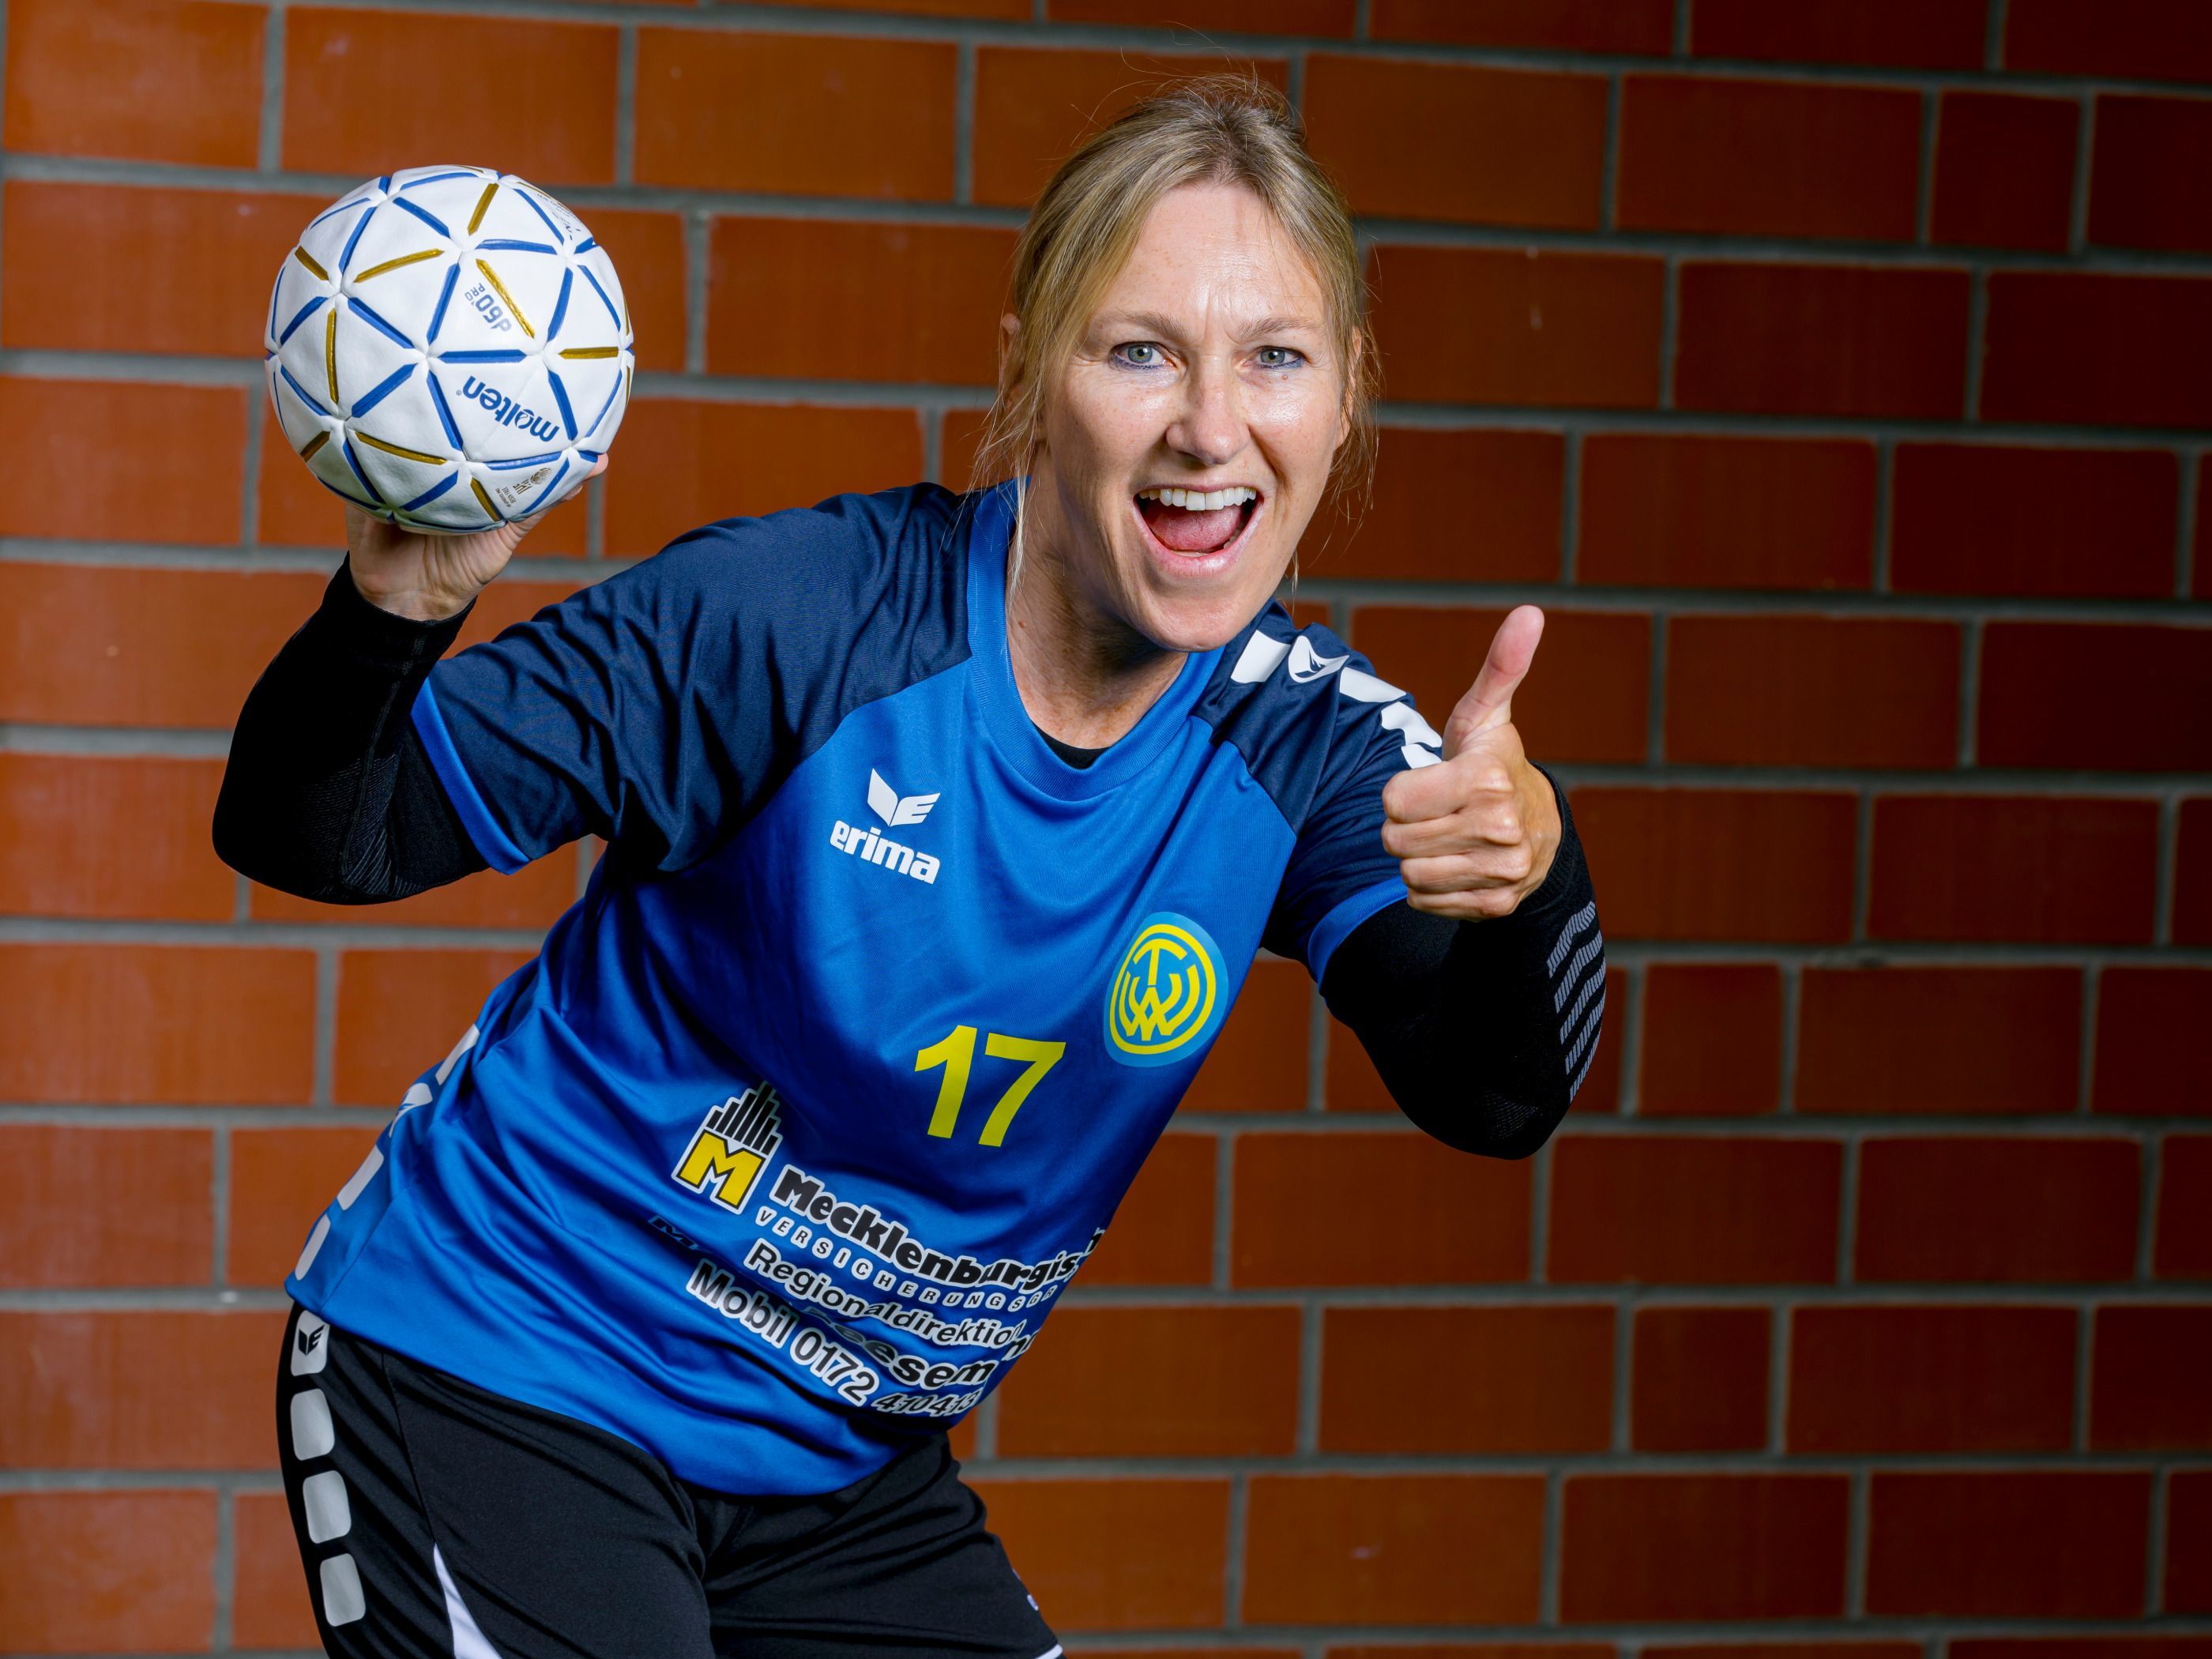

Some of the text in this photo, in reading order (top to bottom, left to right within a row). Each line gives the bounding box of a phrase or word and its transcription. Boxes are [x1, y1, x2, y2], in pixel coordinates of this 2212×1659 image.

[465, 283, 486, 302] PRO
[462, 375, 560, 442] molten
[830, 819, 940, 884] erima
[915, 1025, 1066, 1147] 17
[687, 1260, 799, 1346] Mobil
[792, 1328, 878, 1405] 0172
